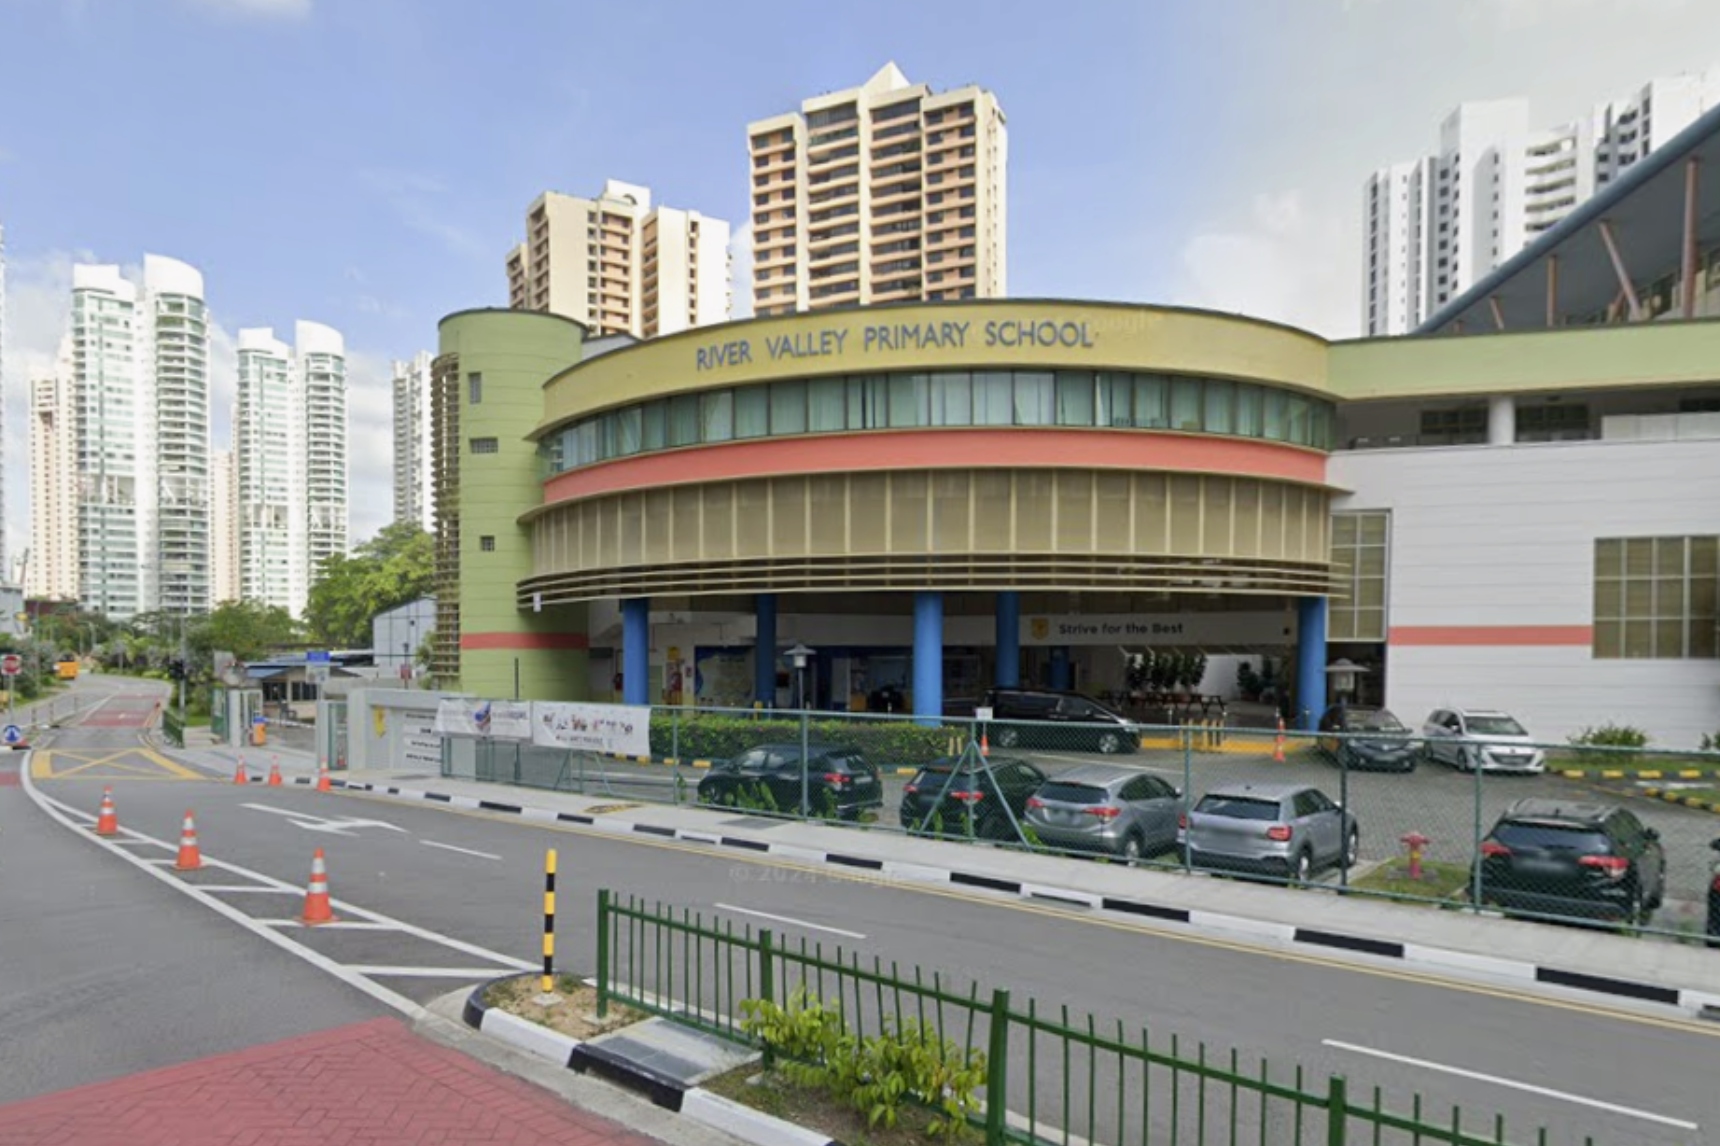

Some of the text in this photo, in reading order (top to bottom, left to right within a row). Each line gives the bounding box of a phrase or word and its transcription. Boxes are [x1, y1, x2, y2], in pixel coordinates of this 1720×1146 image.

[696, 340, 752, 371] RIVER
[766, 329, 848, 361] VALLEY
[863, 321, 970, 352] PRIMARY
[985, 320, 1095, 349] SCHOOL
[1059, 623, 1183, 635] Strive for the Best
